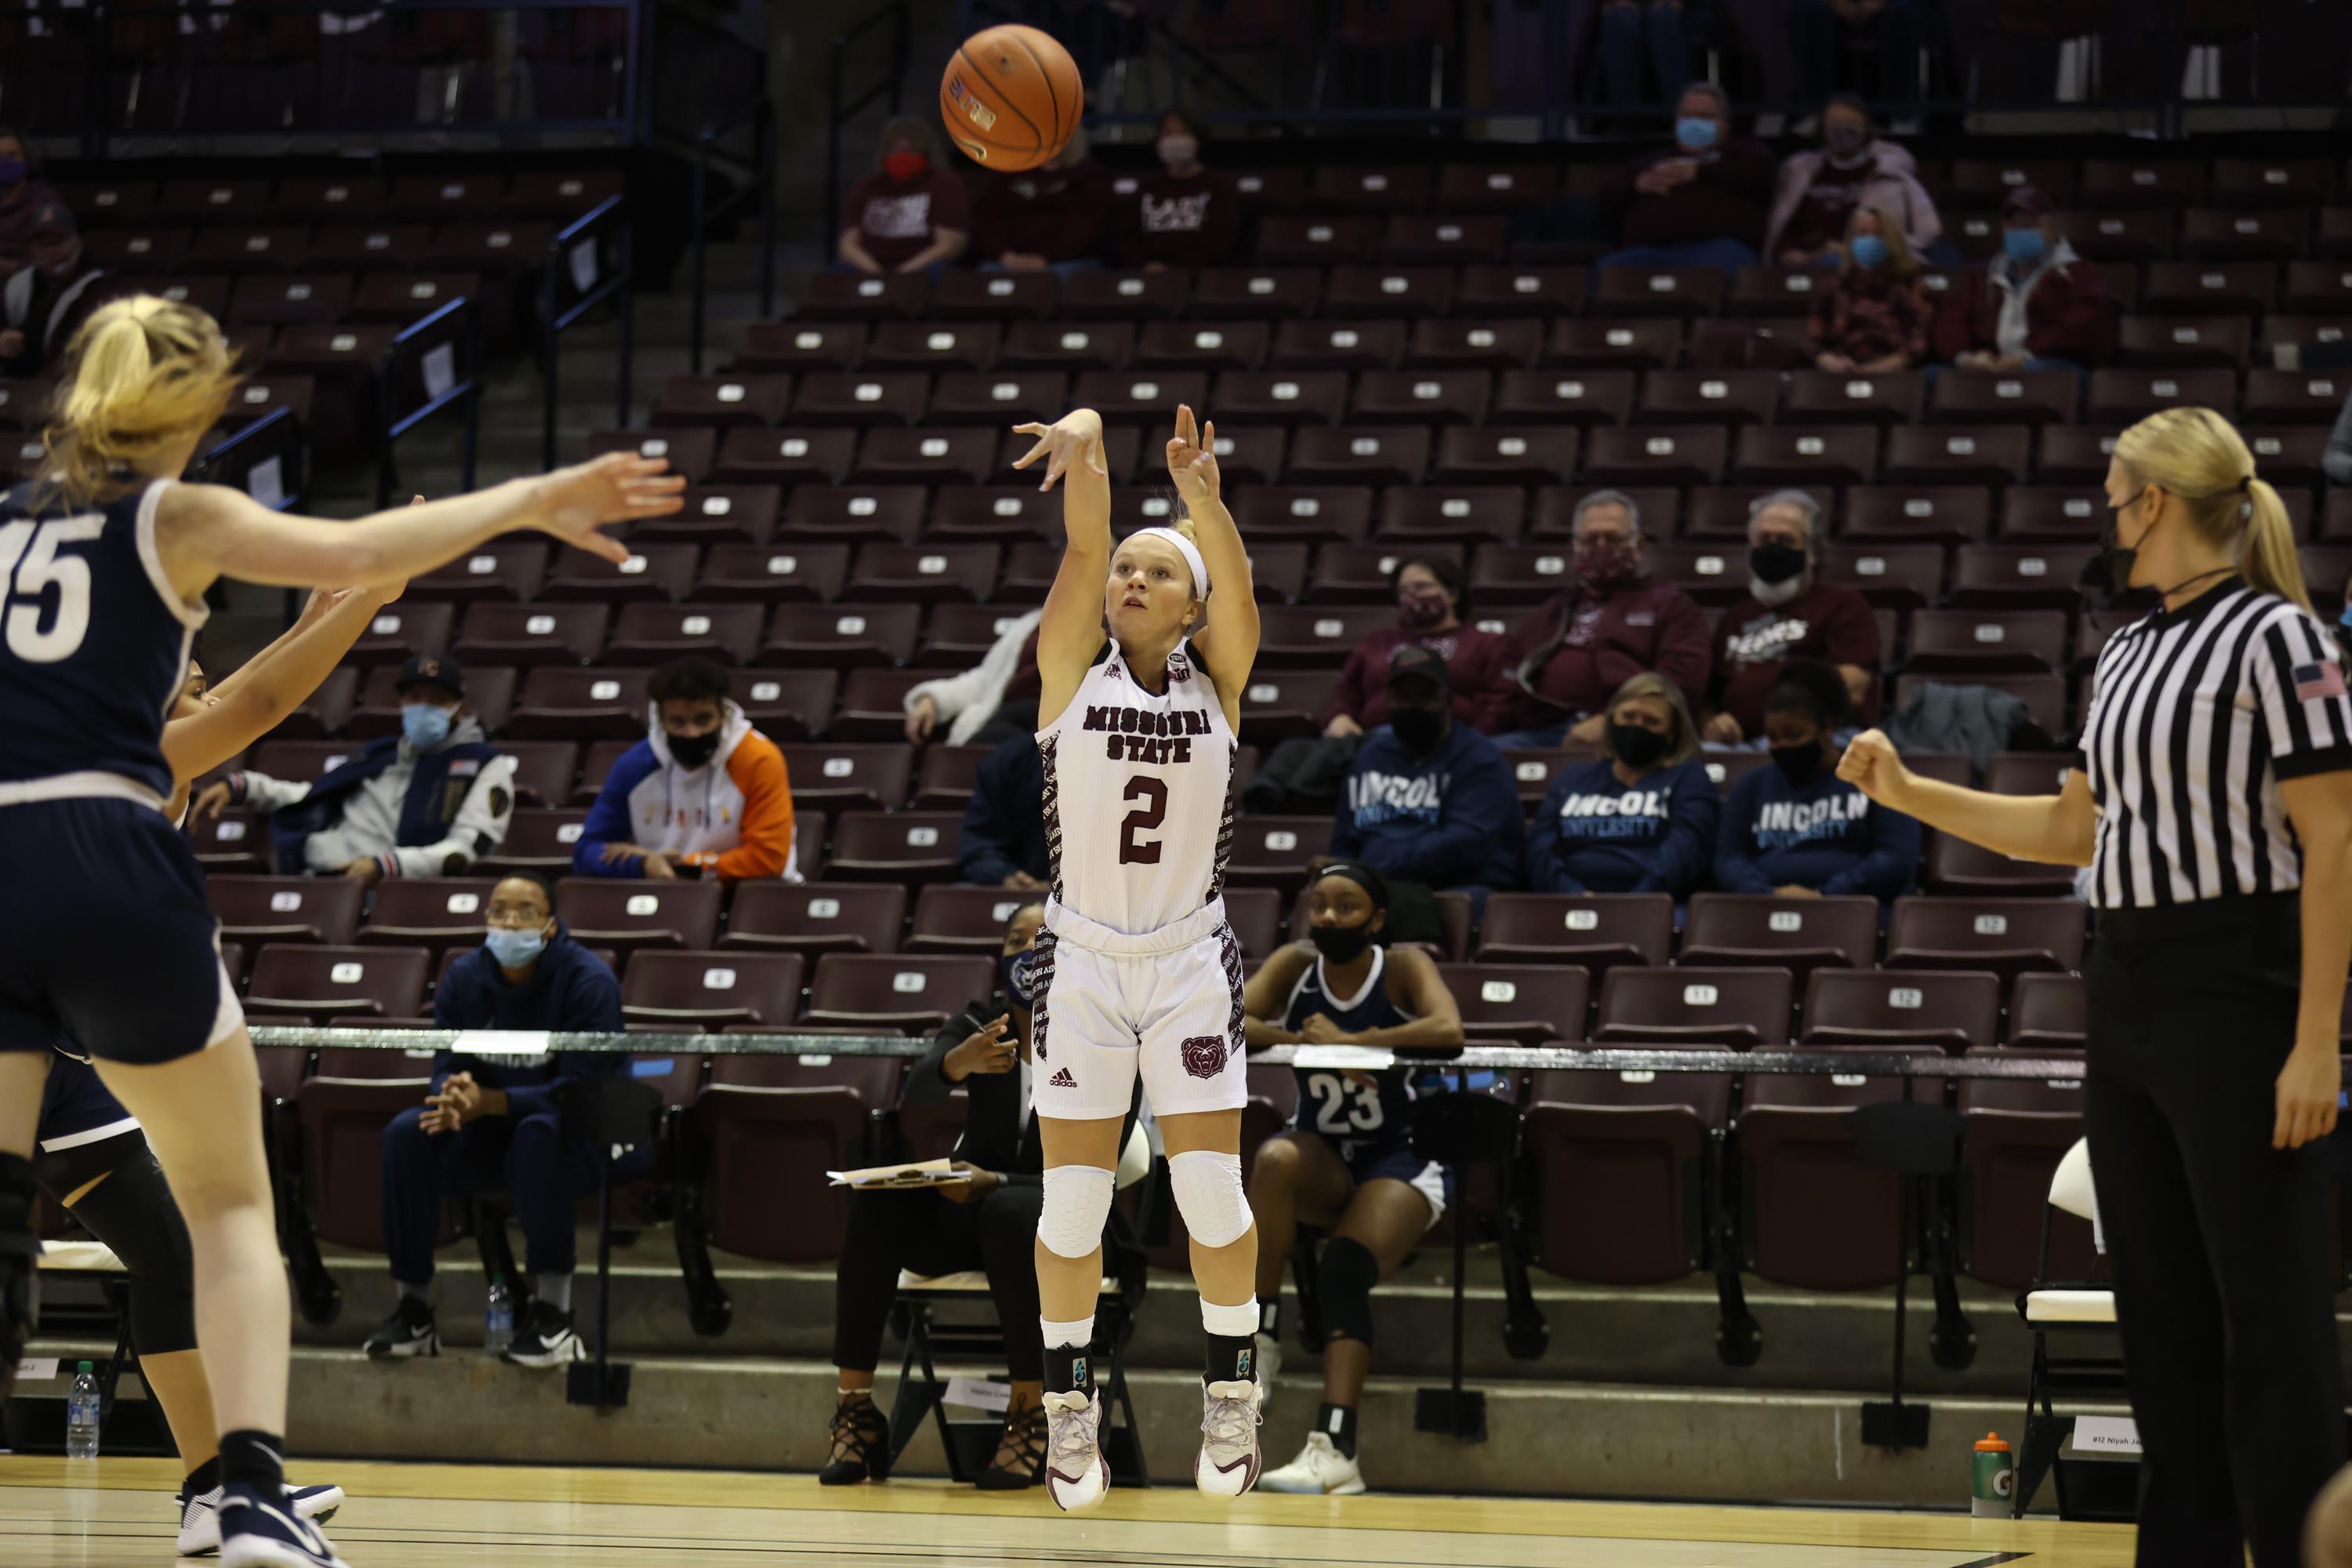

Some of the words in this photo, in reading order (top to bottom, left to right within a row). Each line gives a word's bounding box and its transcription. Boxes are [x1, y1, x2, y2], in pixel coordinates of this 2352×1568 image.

[0, 512, 108, 663] 15
[1083, 706, 1212, 738] MISSOURI
[1106, 734, 1191, 764] STATE
[1120, 775, 1168, 864] 2
[1751, 793, 1869, 833] INCOLN
[1050, 1079, 1078, 1088] adidas
[1308, 1073, 1384, 1134] 23
[2107, 1437, 2129, 1446] Niyah
